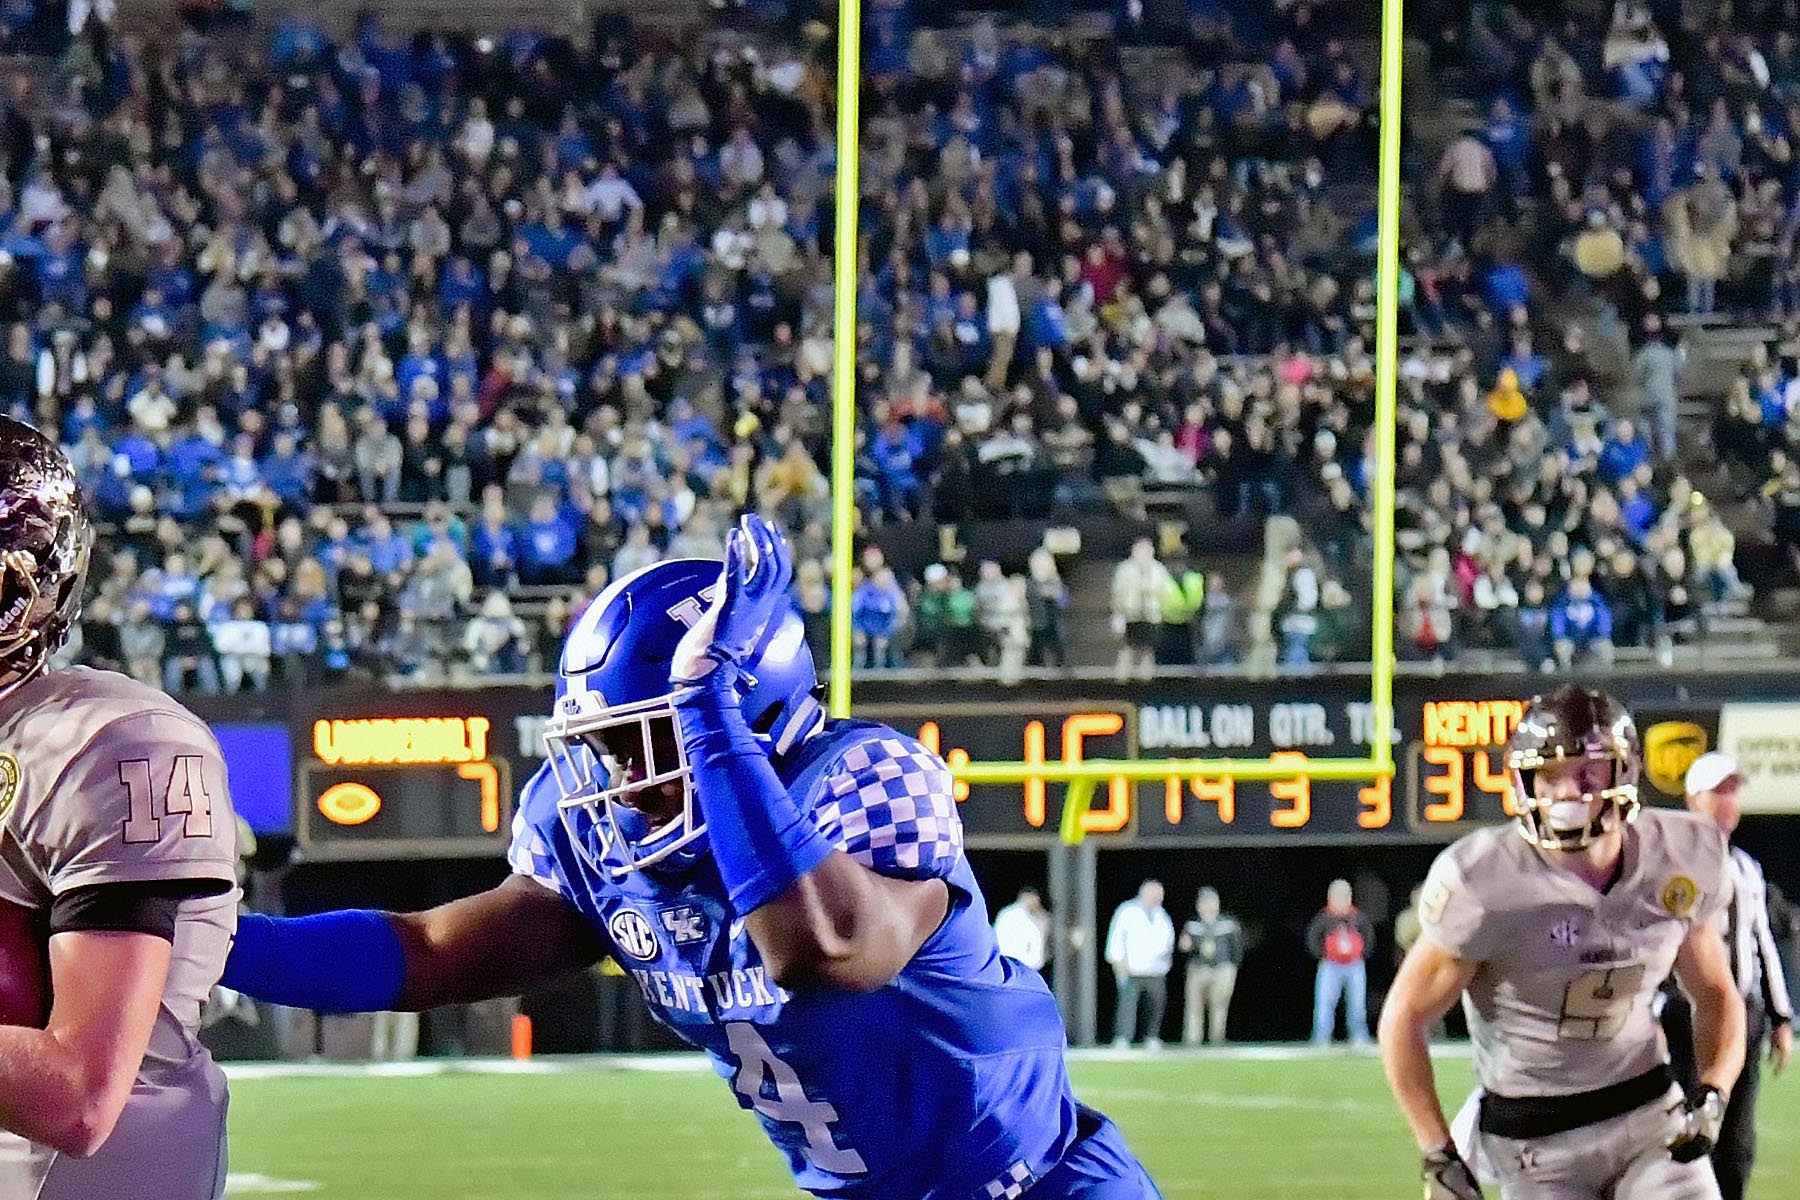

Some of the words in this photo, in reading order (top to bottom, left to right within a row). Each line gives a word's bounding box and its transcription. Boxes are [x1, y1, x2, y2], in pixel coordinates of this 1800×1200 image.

[1138, 704, 1209, 748] BALL
[1210, 704, 1254, 747] ON
[117, 755, 212, 844] 14
[457, 761, 499, 833] 7
[1270, 751, 1311, 828] 3
[726, 1022, 869, 1174] 4
